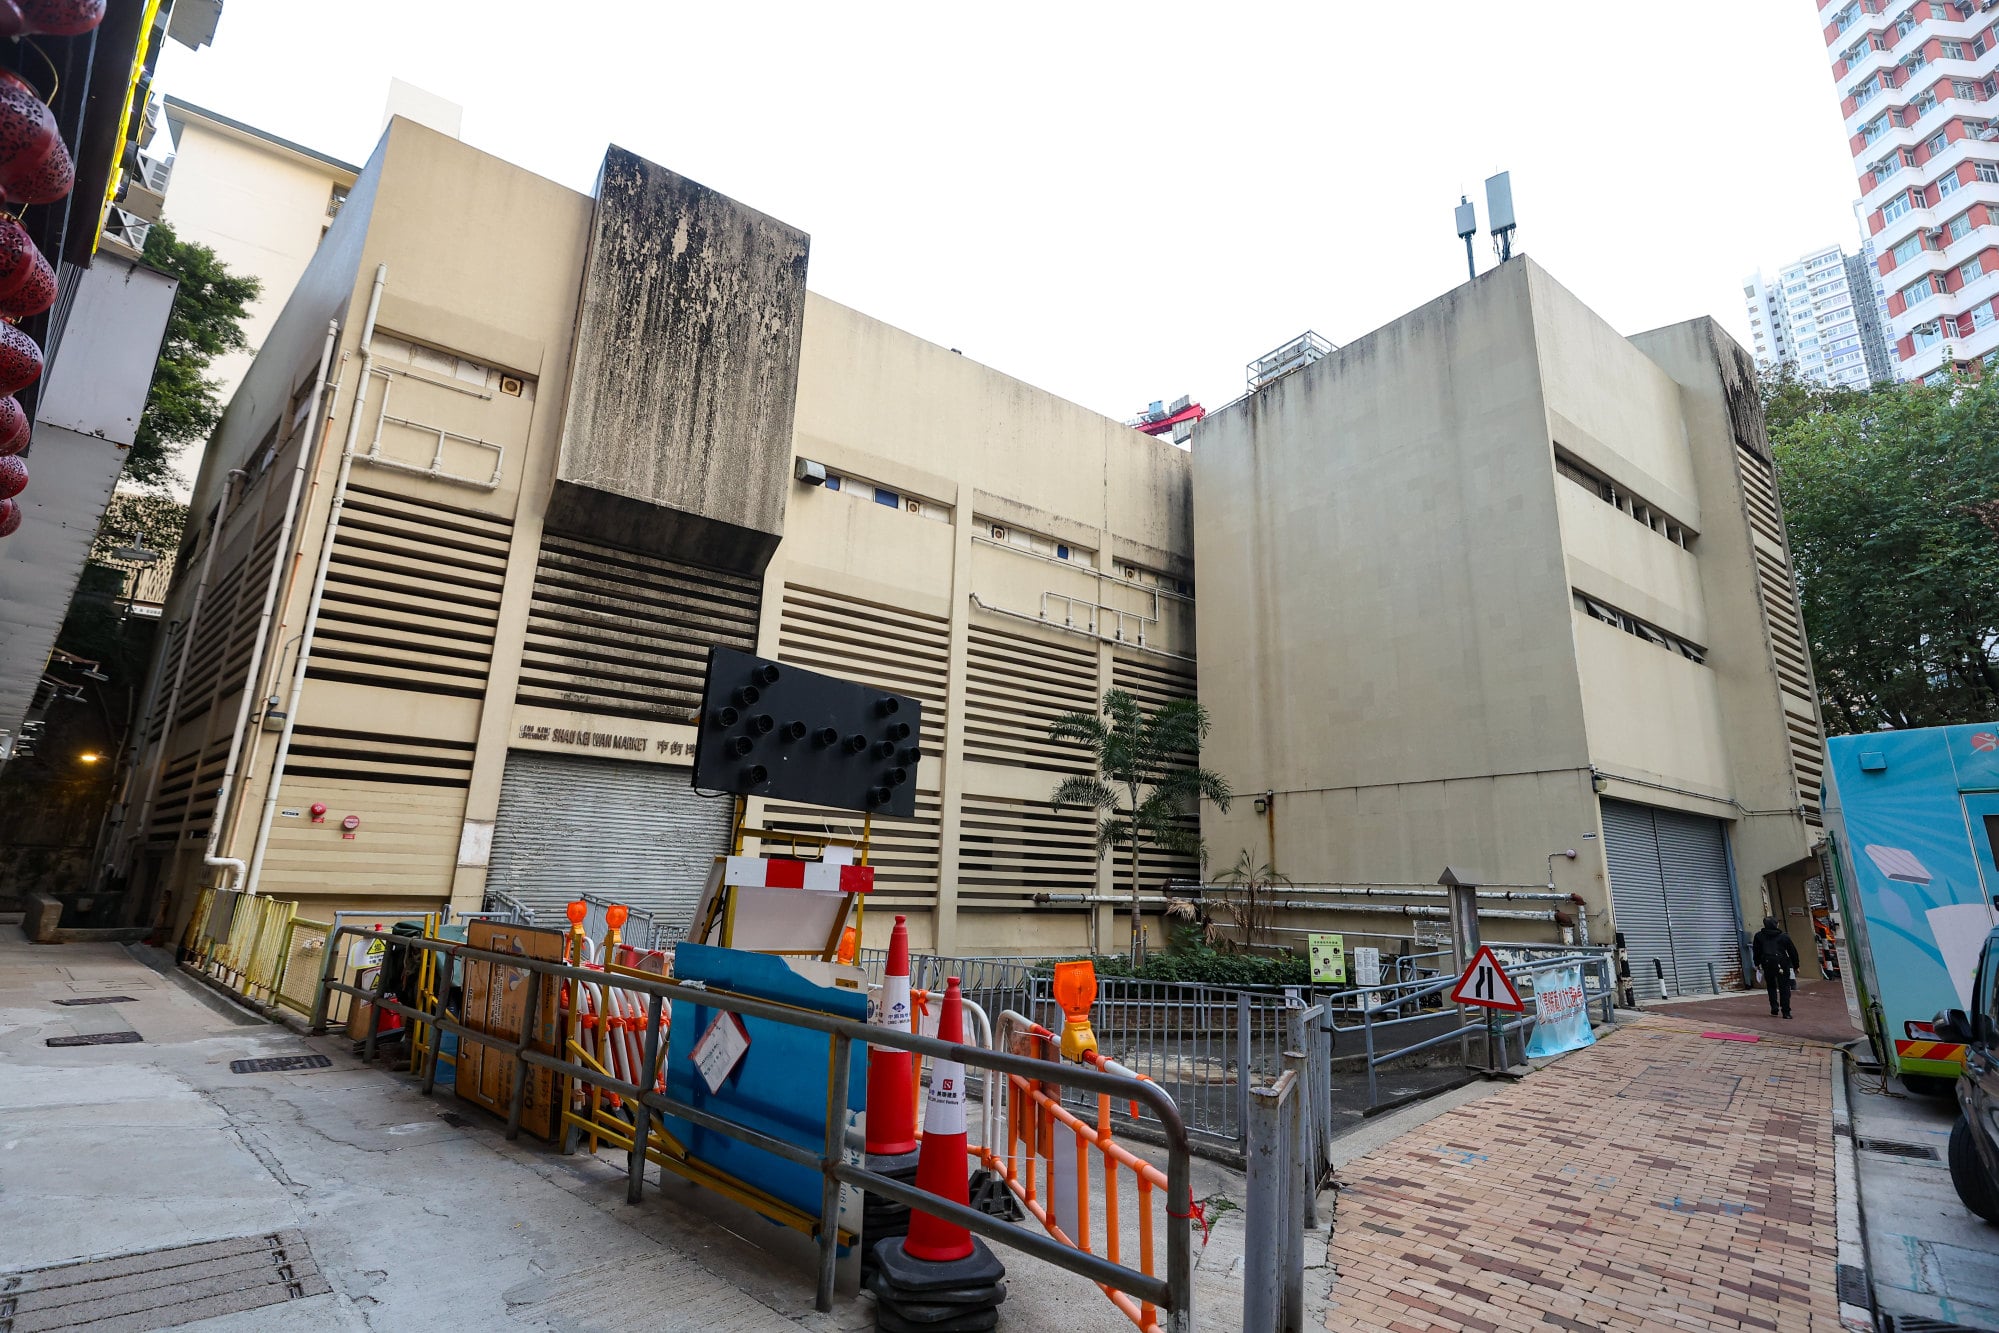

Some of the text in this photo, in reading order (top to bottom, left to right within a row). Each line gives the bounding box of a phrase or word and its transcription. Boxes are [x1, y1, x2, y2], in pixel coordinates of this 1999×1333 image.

[552, 728, 648, 753] SHAU KEI WAN MARKET
